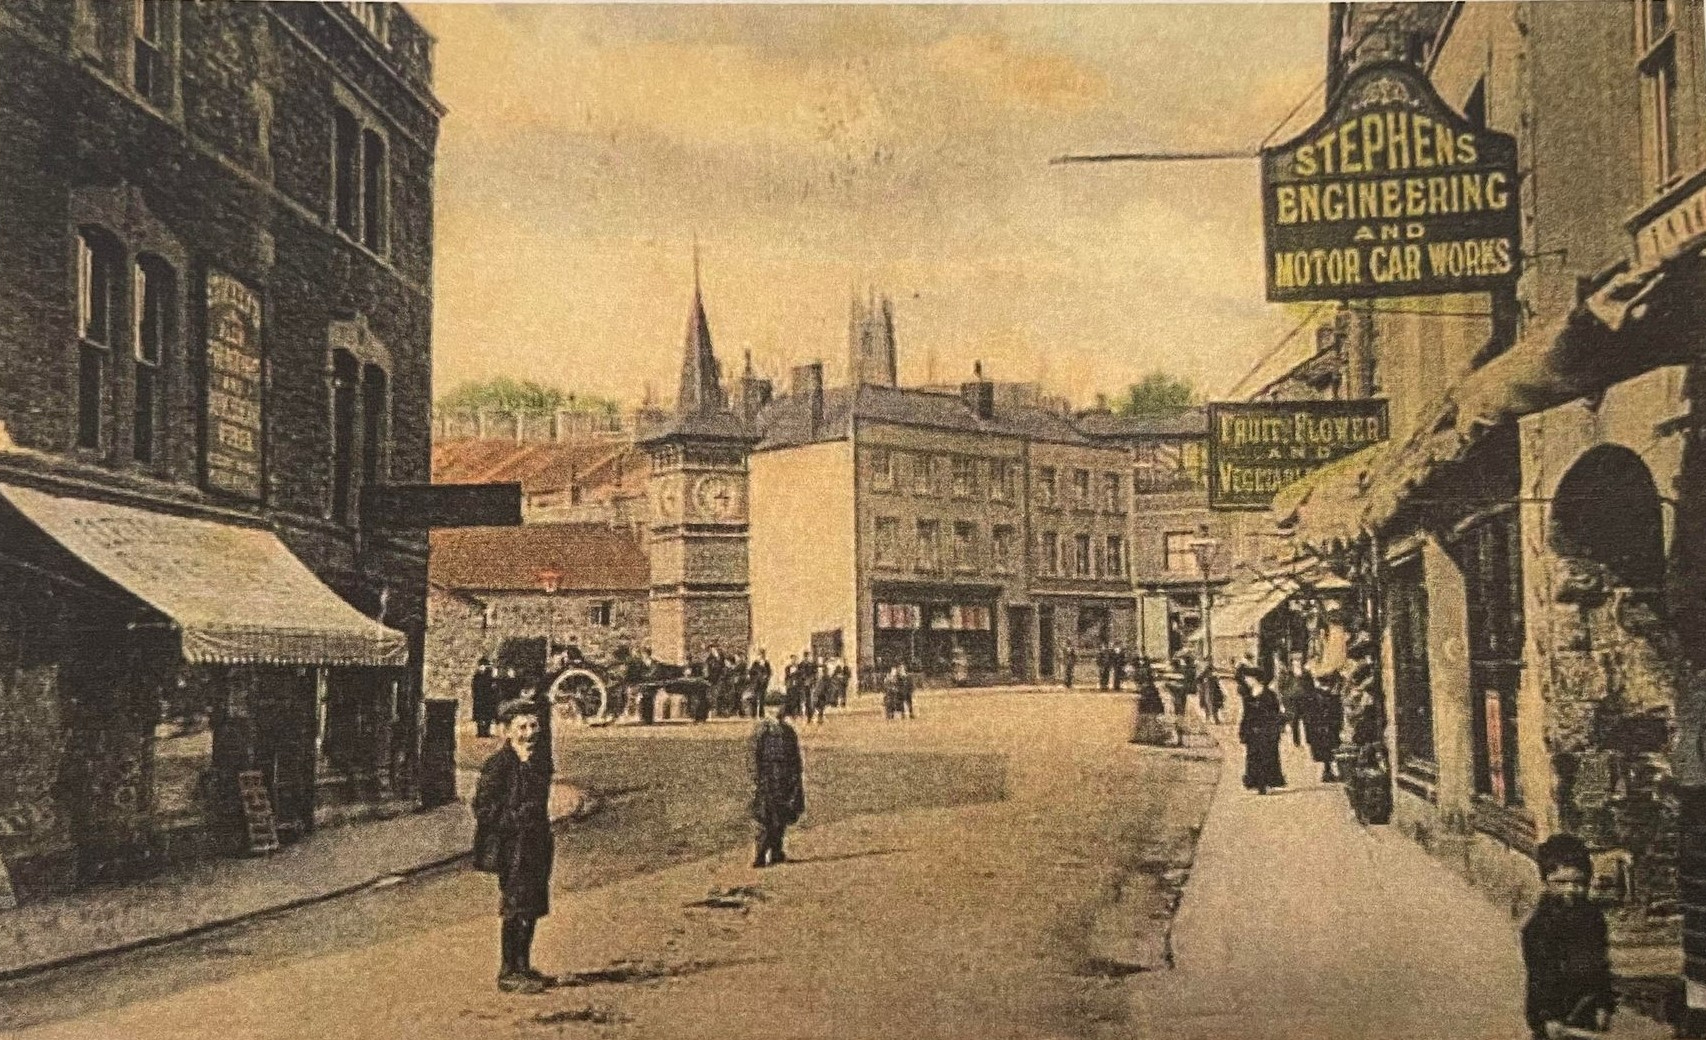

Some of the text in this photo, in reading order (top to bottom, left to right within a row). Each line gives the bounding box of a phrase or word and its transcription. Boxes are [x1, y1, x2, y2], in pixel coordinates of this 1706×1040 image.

[1296, 111, 1477, 176] STEPHENS
[1276, 172, 1508, 225] ENGINEERING
[1354, 222, 1426, 240] AND
[1275, 238, 1514, 287] MOTOR CAR WORKS
[1268, 446, 1331, 459] AND
